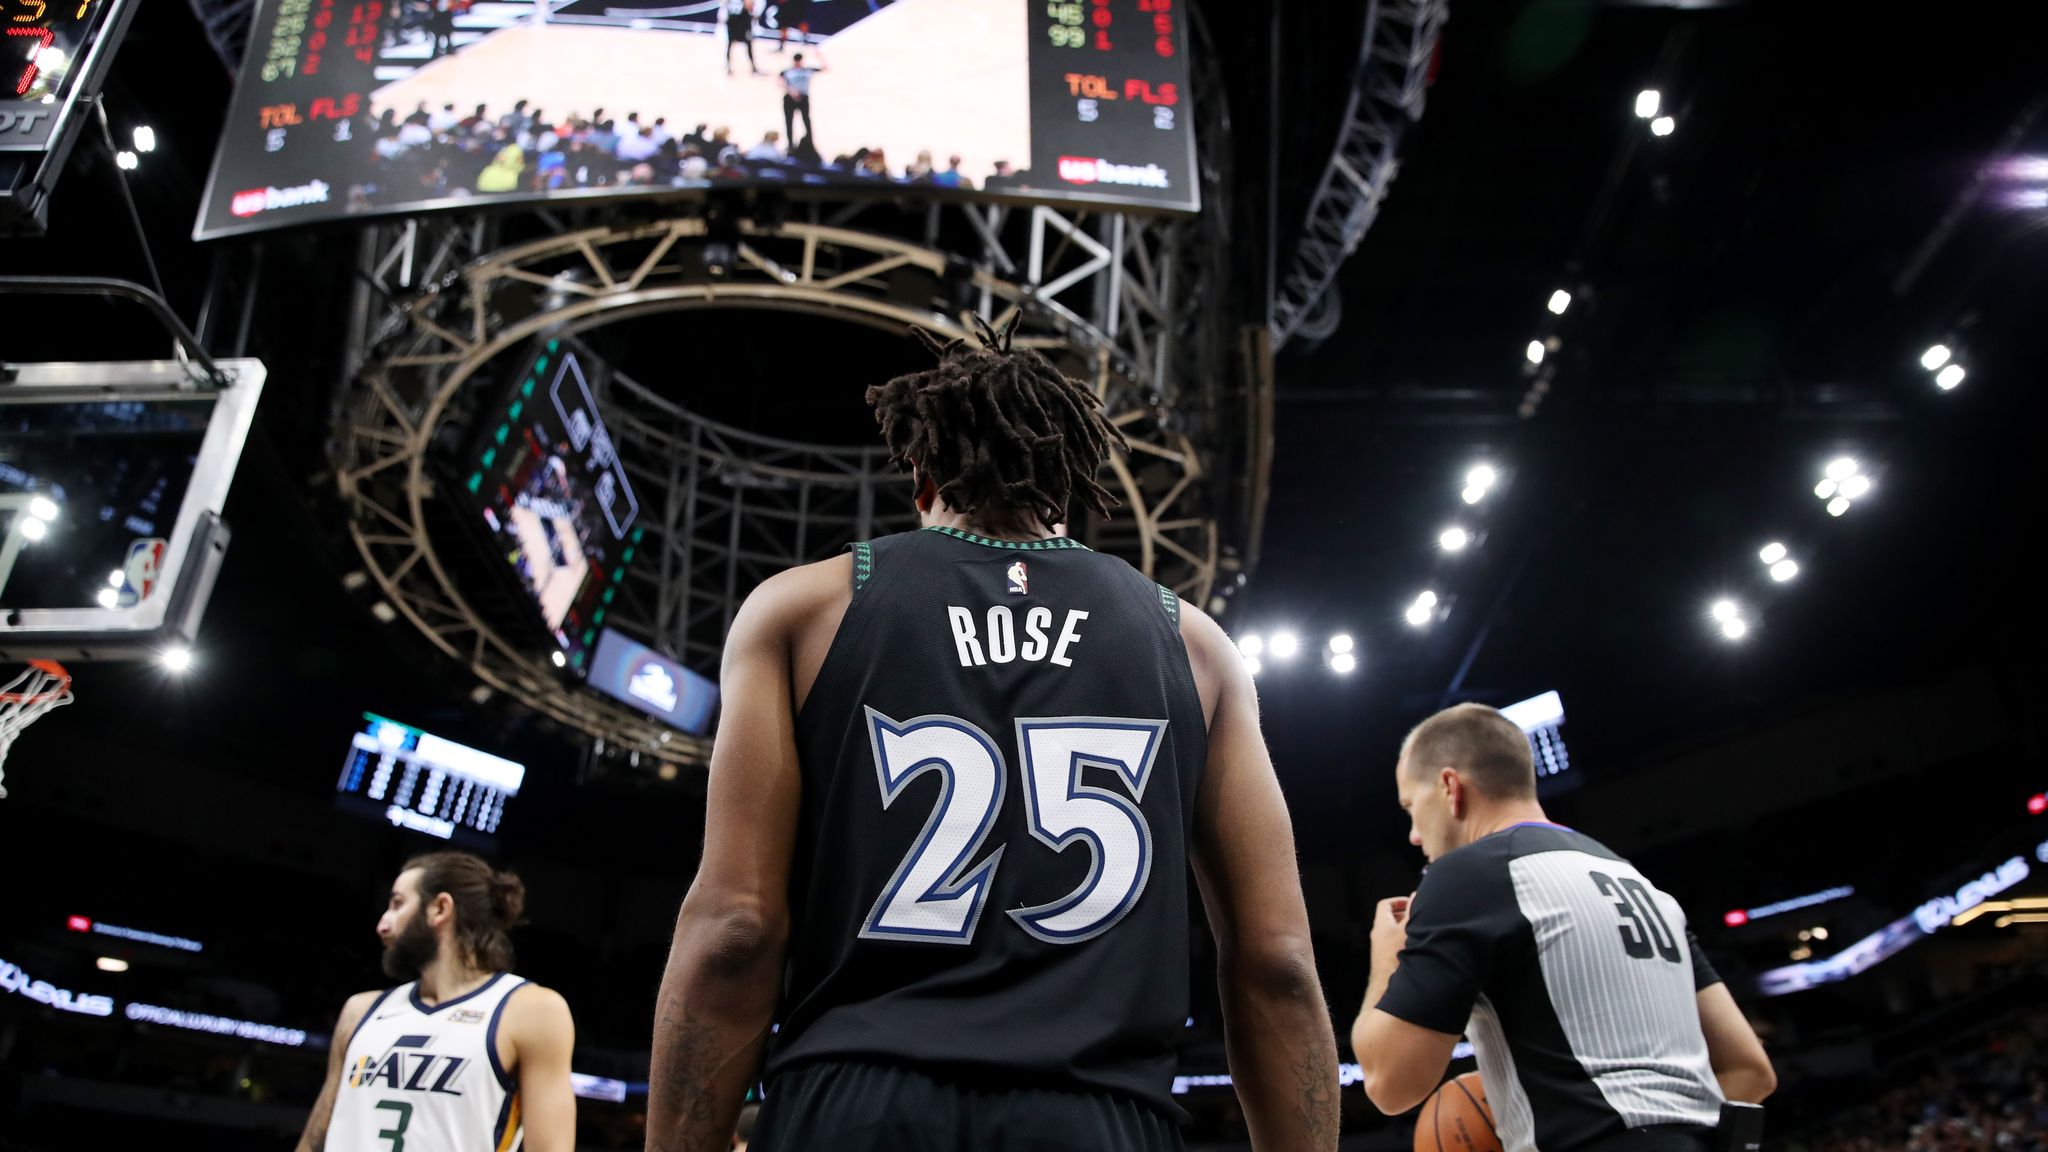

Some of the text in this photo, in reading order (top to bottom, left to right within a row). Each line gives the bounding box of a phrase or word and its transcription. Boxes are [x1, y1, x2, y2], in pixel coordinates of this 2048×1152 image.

[1048, 24, 1085, 48] 99
[261, 58, 297, 81] 67
[1064, 72, 1179, 106] TOL FLS
[260, 92, 361, 129] TOL FLS
[1077, 98, 1175, 130] 5 2
[947, 604, 1090, 668] ROSE
[857, 704, 1170, 945] 25
[1588, 869, 1683, 965] 30
[19, 971, 114, 1017] LEXUS
[350, 1034, 475, 1096] JAZZ
[375, 1100, 413, 1152] 3
